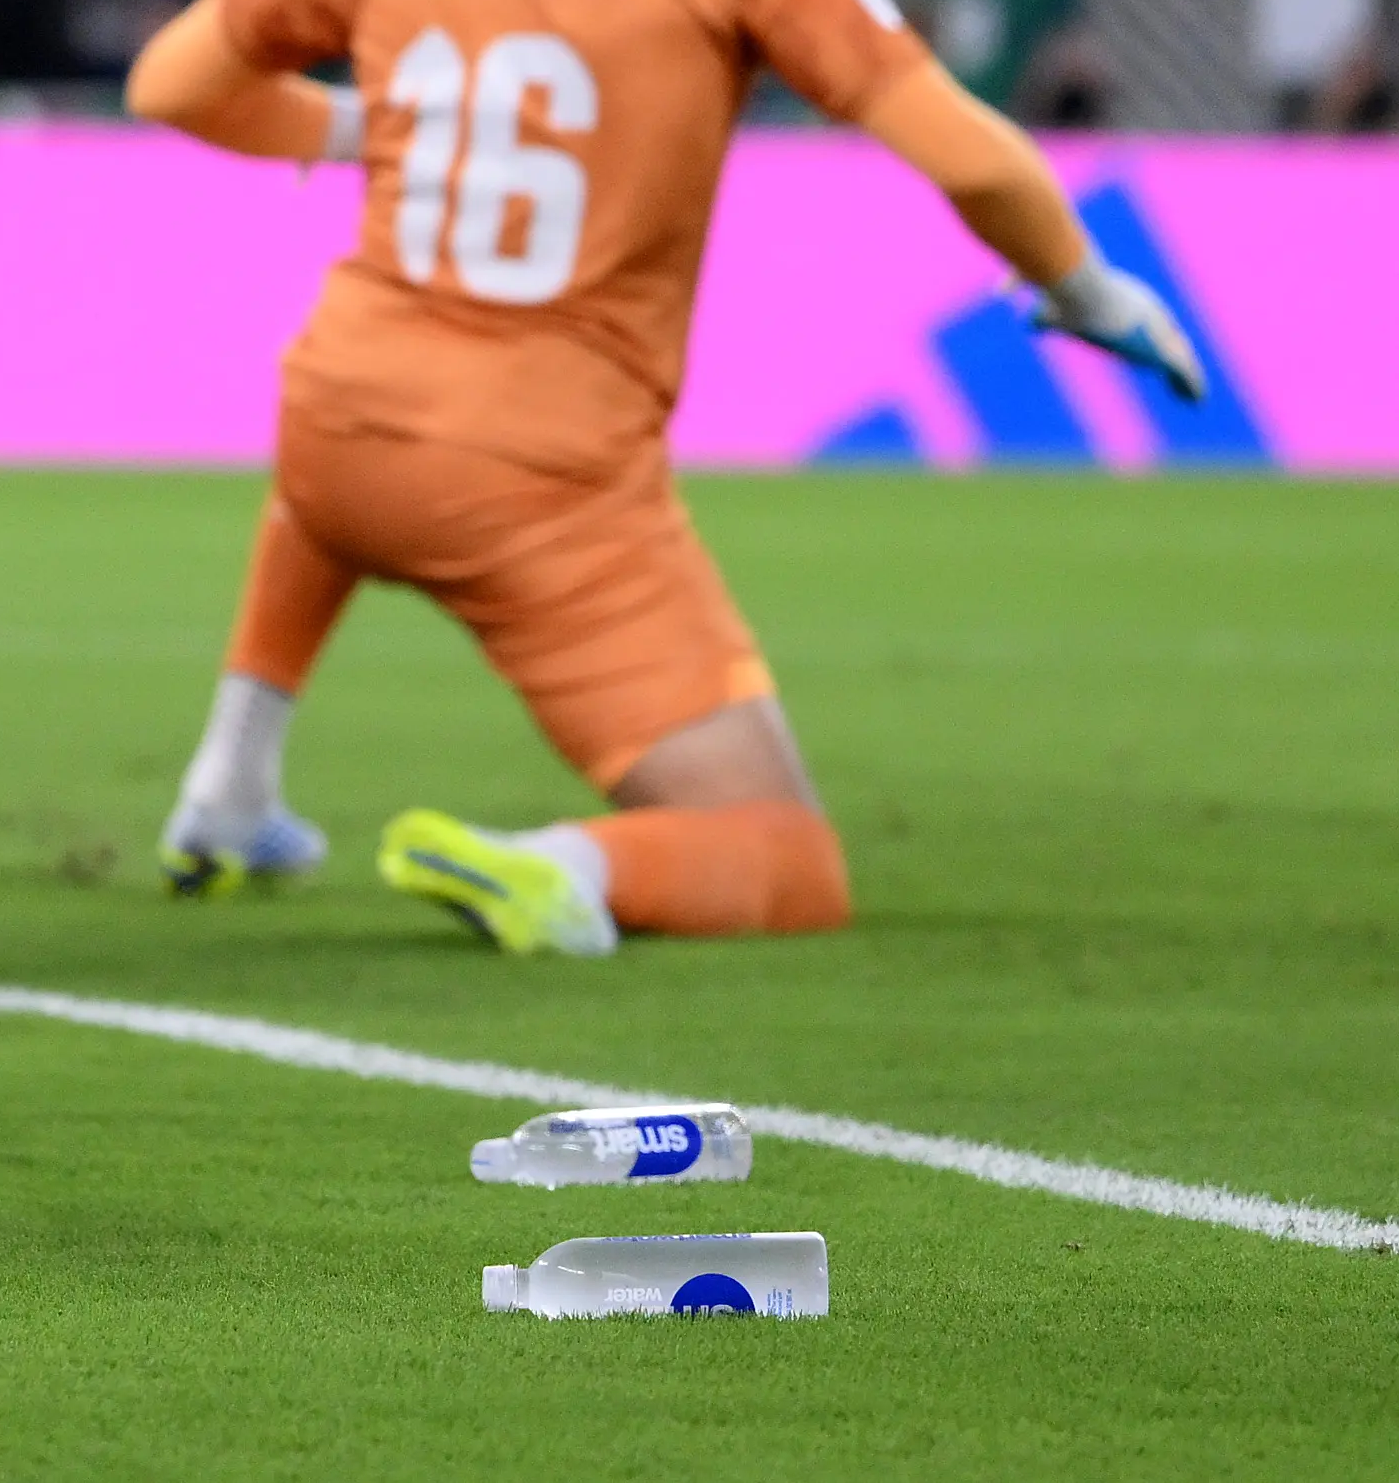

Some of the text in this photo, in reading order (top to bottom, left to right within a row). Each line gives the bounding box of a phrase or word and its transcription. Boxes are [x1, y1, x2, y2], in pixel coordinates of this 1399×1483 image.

[388, 23, 600, 306] 16
[587, 1124, 690, 1162] smart
[605, 1287, 662, 1303] water
